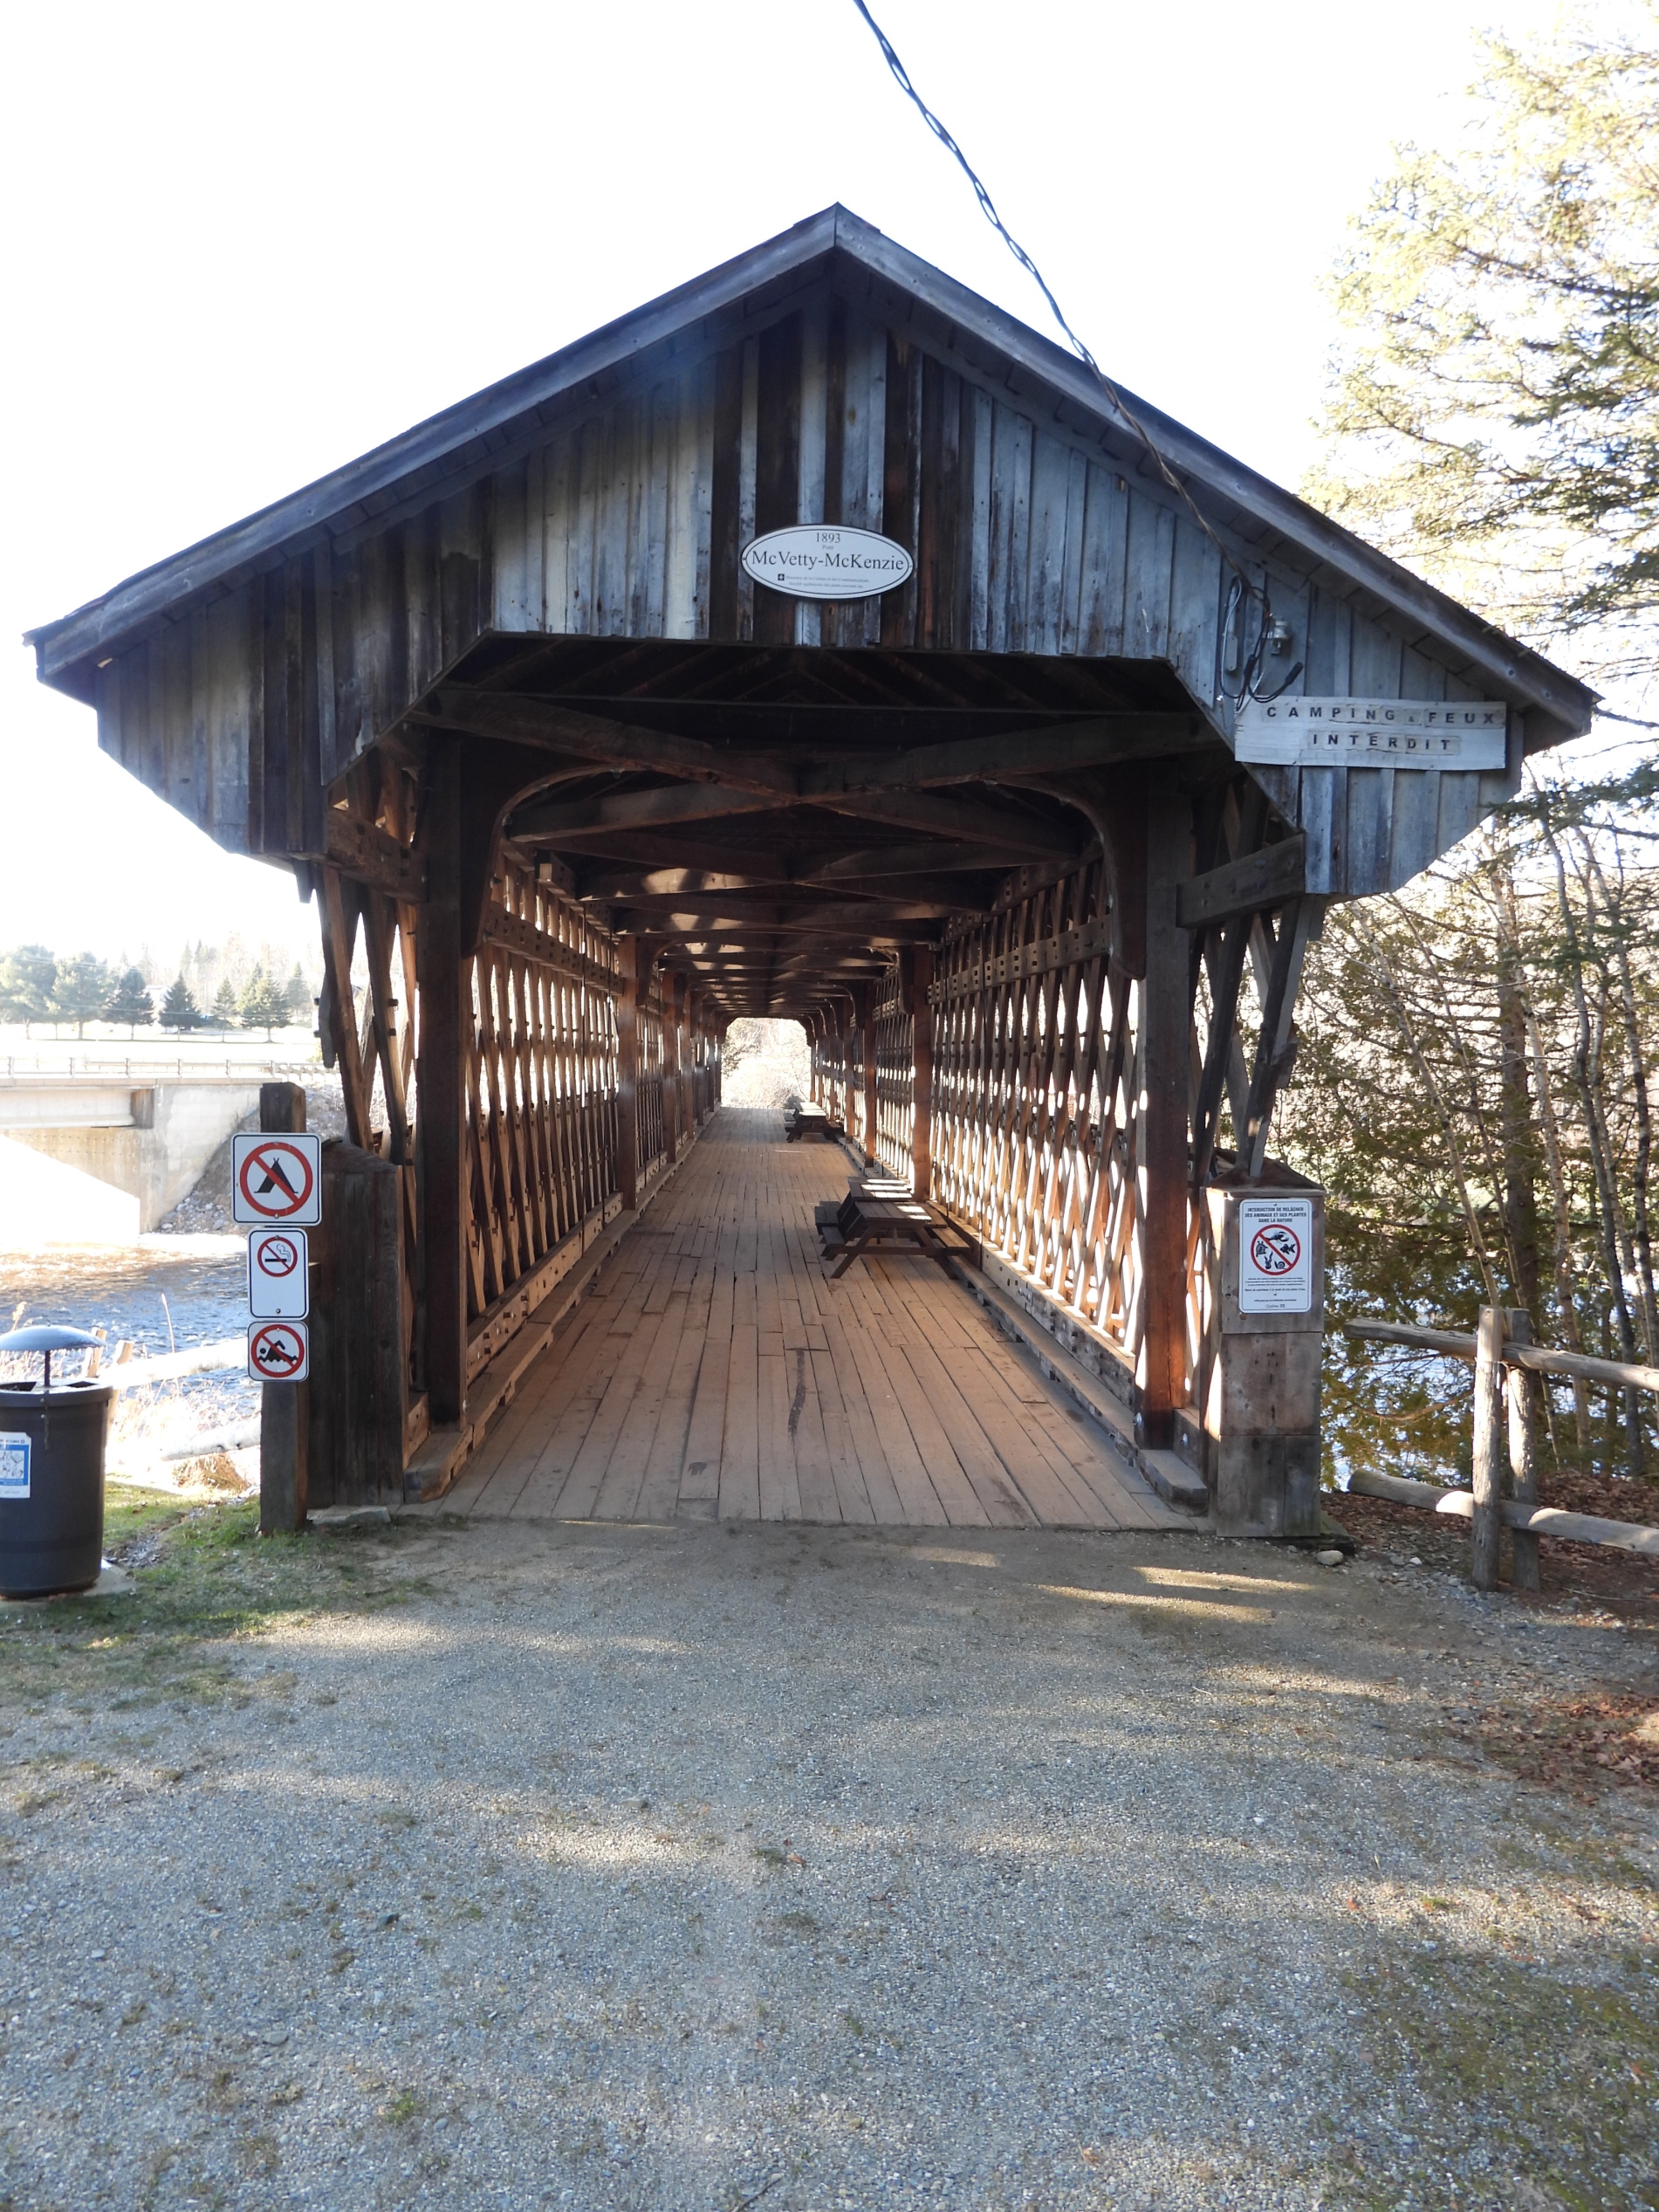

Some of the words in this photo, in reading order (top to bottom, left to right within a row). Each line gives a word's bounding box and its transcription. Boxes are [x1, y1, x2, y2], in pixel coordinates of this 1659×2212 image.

[815, 532, 841, 544] 1893
[751, 550, 904, 570] McVetty-McKenzie
[1266, 706, 1395, 721] CAMPING
[1428, 711, 1495, 725] FEUX
[1313, 733, 1451, 751] INTERDIT
